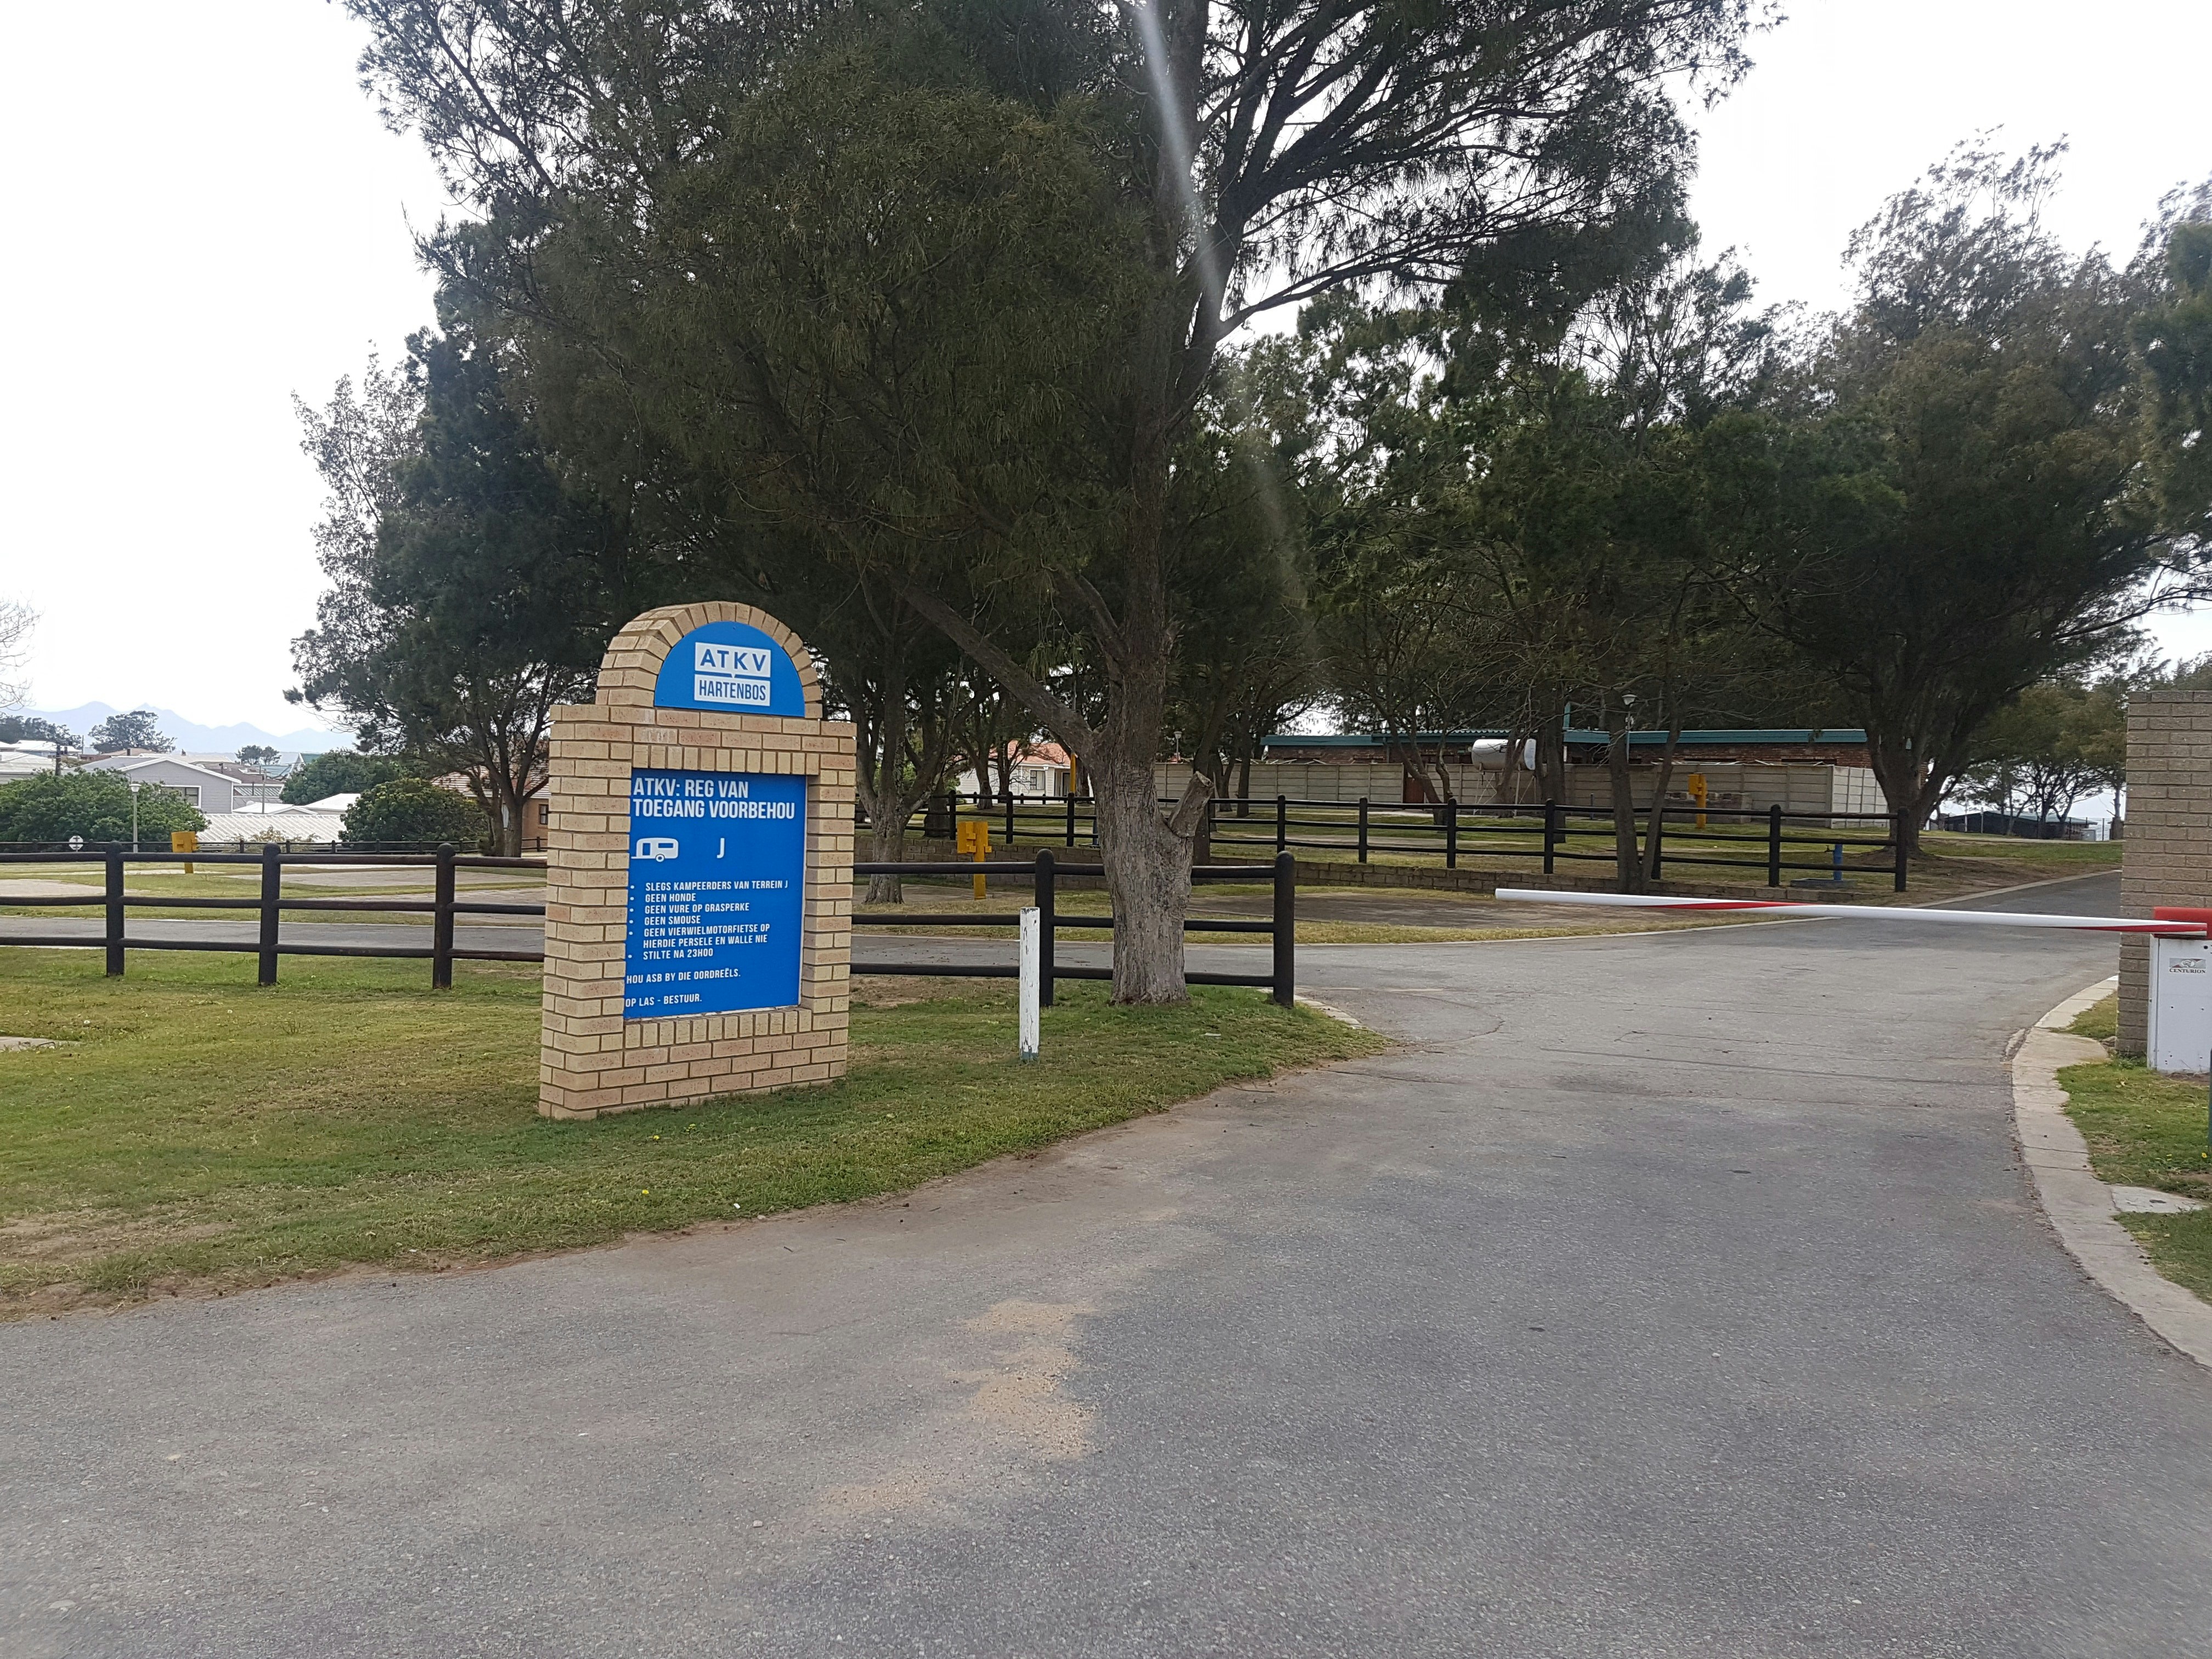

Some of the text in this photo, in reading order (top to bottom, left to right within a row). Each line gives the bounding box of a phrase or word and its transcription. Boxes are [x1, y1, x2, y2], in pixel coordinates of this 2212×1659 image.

[700, 648, 766, 672] ATKV
[699, 680, 766, 701] HARTENBOS
[633, 777, 748, 798] ATKV: REG VAN
[633, 799, 795, 819] TOEGANG VOORBEHOU
[716, 838, 725, 859] J
[645, 880, 788, 891] SLEGS KAMPEERDERS VAN TERREIN J
[645, 893, 696, 902] GEEN HONDE
[645, 902, 749, 914] GEEN VURE OP GRASPERKE
[644, 915, 701, 926] GEEN SMOUSE
[644, 923, 770, 937] GEEN VIERWIELMOTORFIETSE OP
[643, 934, 768, 949] HIERDIE PERSELE EN WALLE NIE
[643, 948, 713, 960] STILTE NA 23H00
[627, 974, 643, 984] HOU
[646, 973, 662, 983] ASB
[665, 973, 676, 981] BY
[678, 972, 691, 981] DIE
[625, 998, 636, 1007] OP
[639, 997, 654, 1007] LAS
[664, 994, 702, 1005] BESTUUR.
